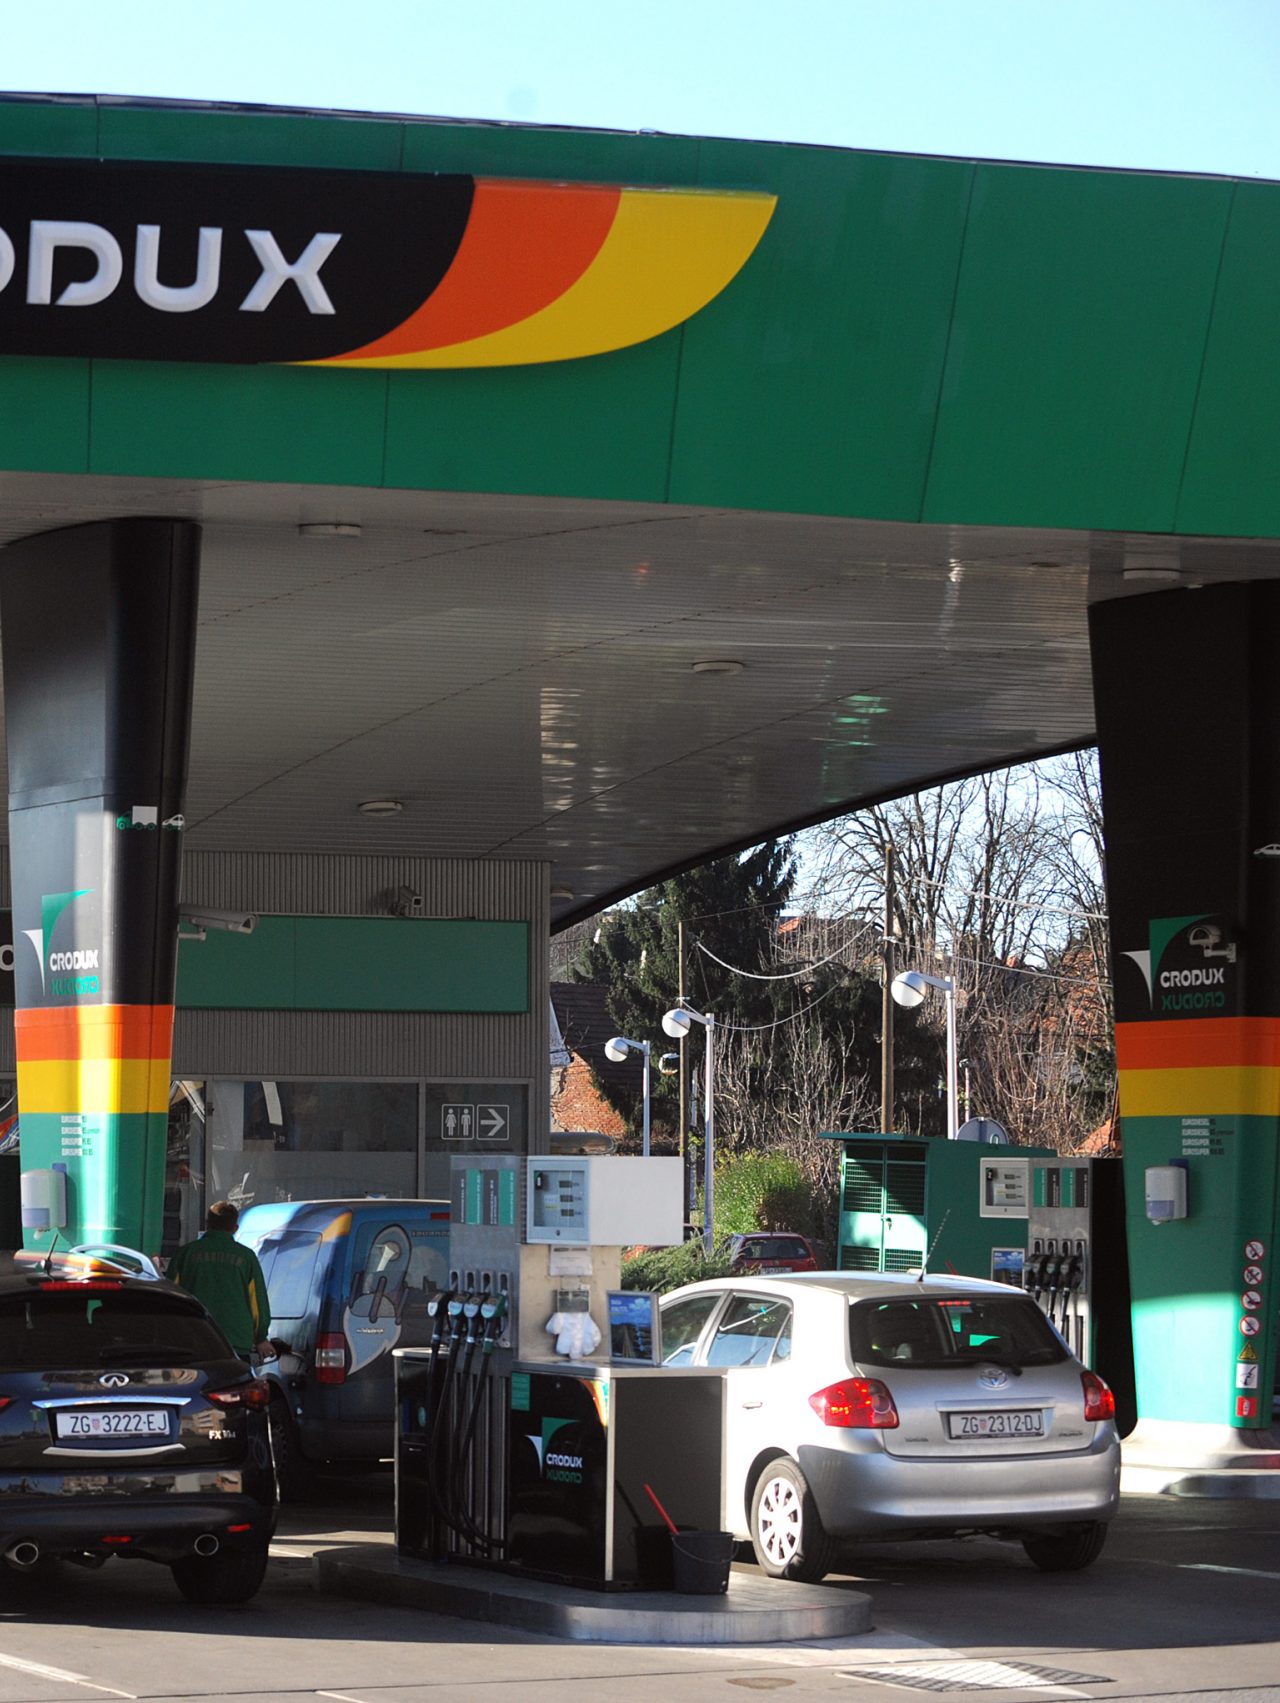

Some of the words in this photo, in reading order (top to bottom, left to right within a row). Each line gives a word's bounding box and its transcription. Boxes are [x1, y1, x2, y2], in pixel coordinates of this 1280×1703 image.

[49, 949, 99, 971] CRODUX
[1160, 967, 1225, 988] CRODUX
[70, 1415, 91, 1434] ZG
[960, 1417, 979, 1434] ZG
[546, 1453, 583, 1468] CRODUX
